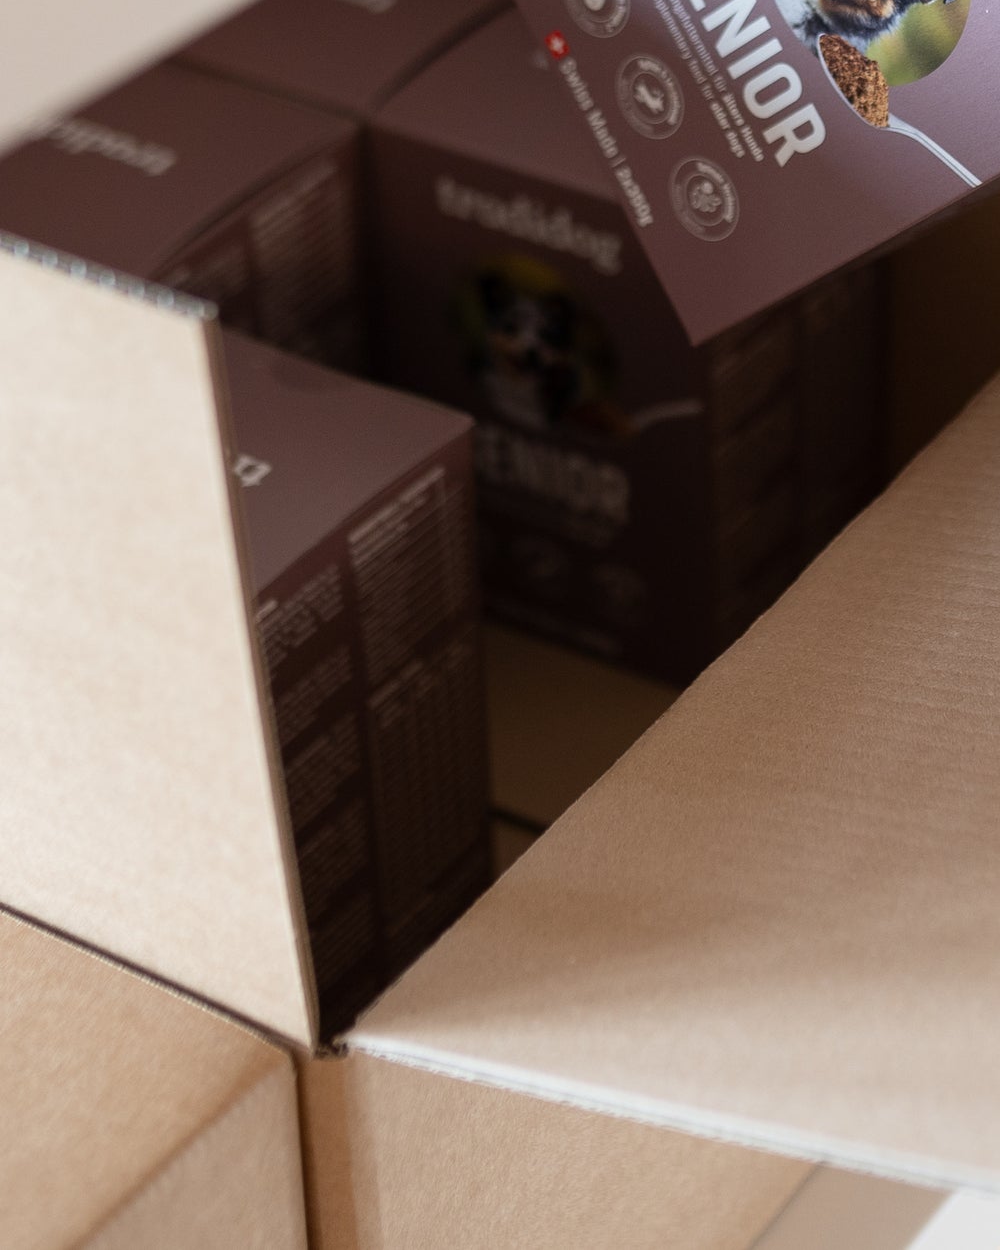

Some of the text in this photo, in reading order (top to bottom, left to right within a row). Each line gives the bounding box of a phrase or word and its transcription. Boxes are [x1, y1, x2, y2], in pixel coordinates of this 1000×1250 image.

[558, 57, 596, 112] Swiss
[585, 110, 620, 160] Made
[613, 166, 654, 227] 2x350g
[709, 100, 731, 131] older
[724, 129, 747, 159] dogs
[740, 125, 764, 162] Hunde
[476, 425, 630, 524] ENIOR
